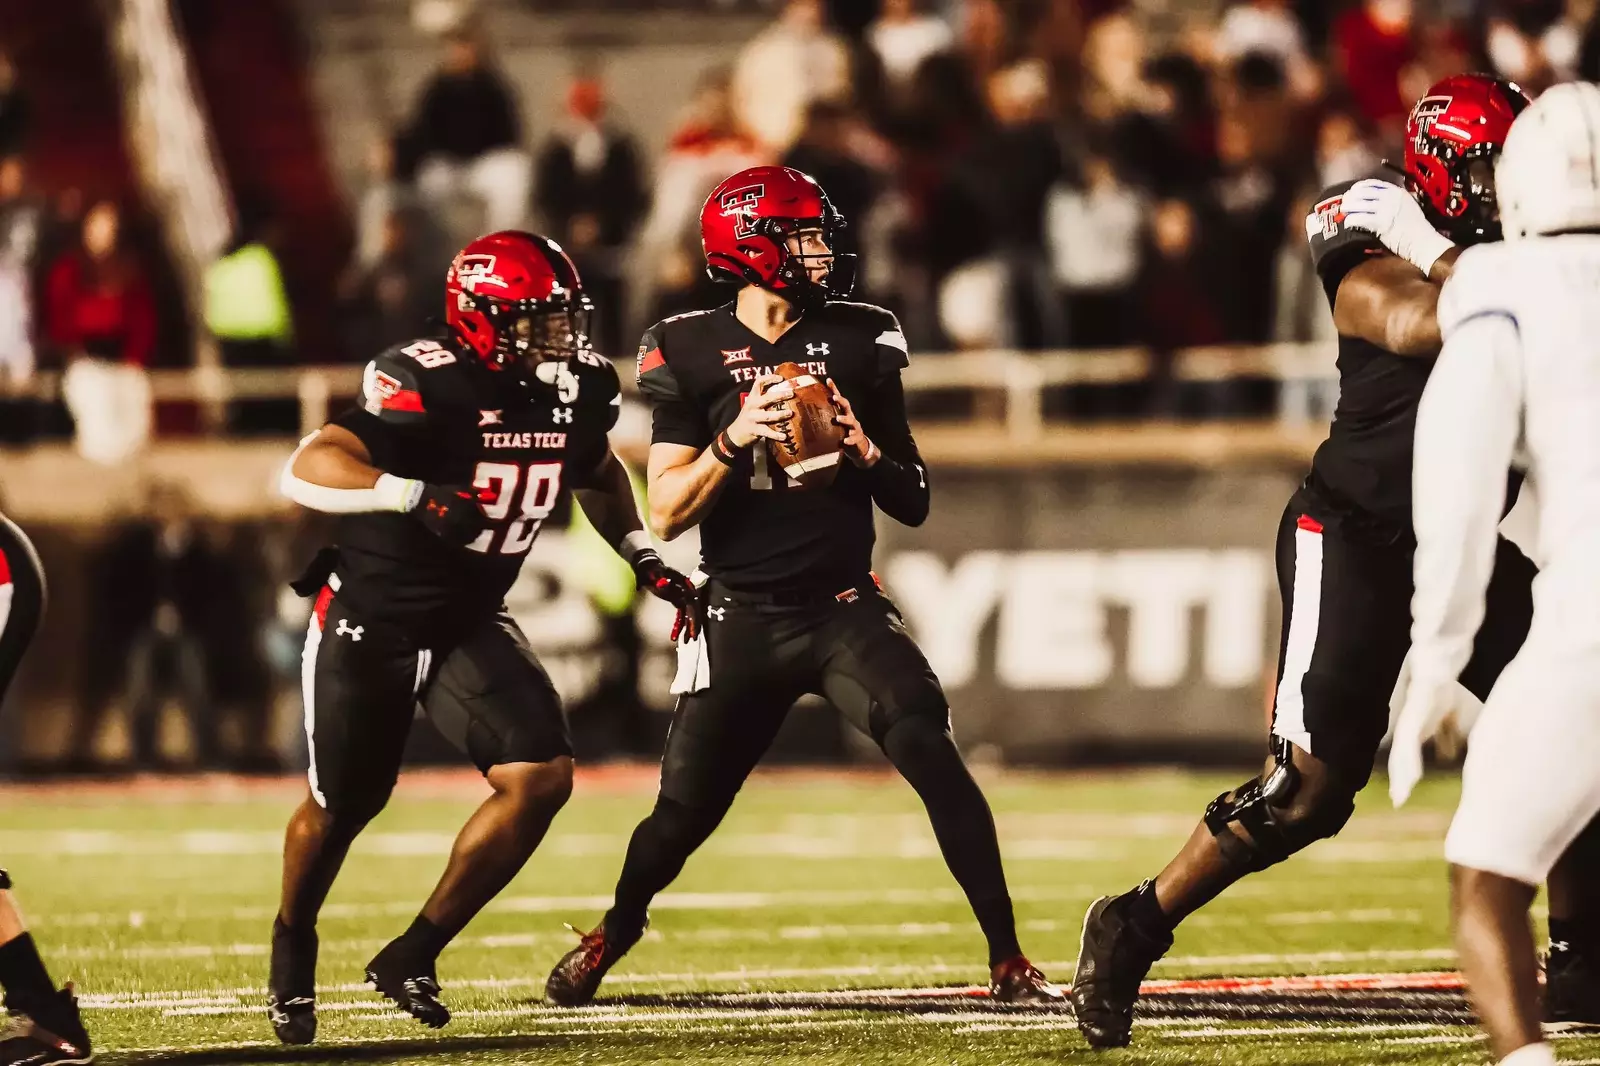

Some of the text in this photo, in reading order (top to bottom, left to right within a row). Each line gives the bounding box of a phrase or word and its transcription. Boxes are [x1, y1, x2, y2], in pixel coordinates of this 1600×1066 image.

[400, 340, 457, 369] 28
[730, 364, 779, 383] TEXA
[482, 432, 567, 448] TEXAS TECH
[464, 461, 563, 554] 28
[888, 551, 1264, 688] YETI
